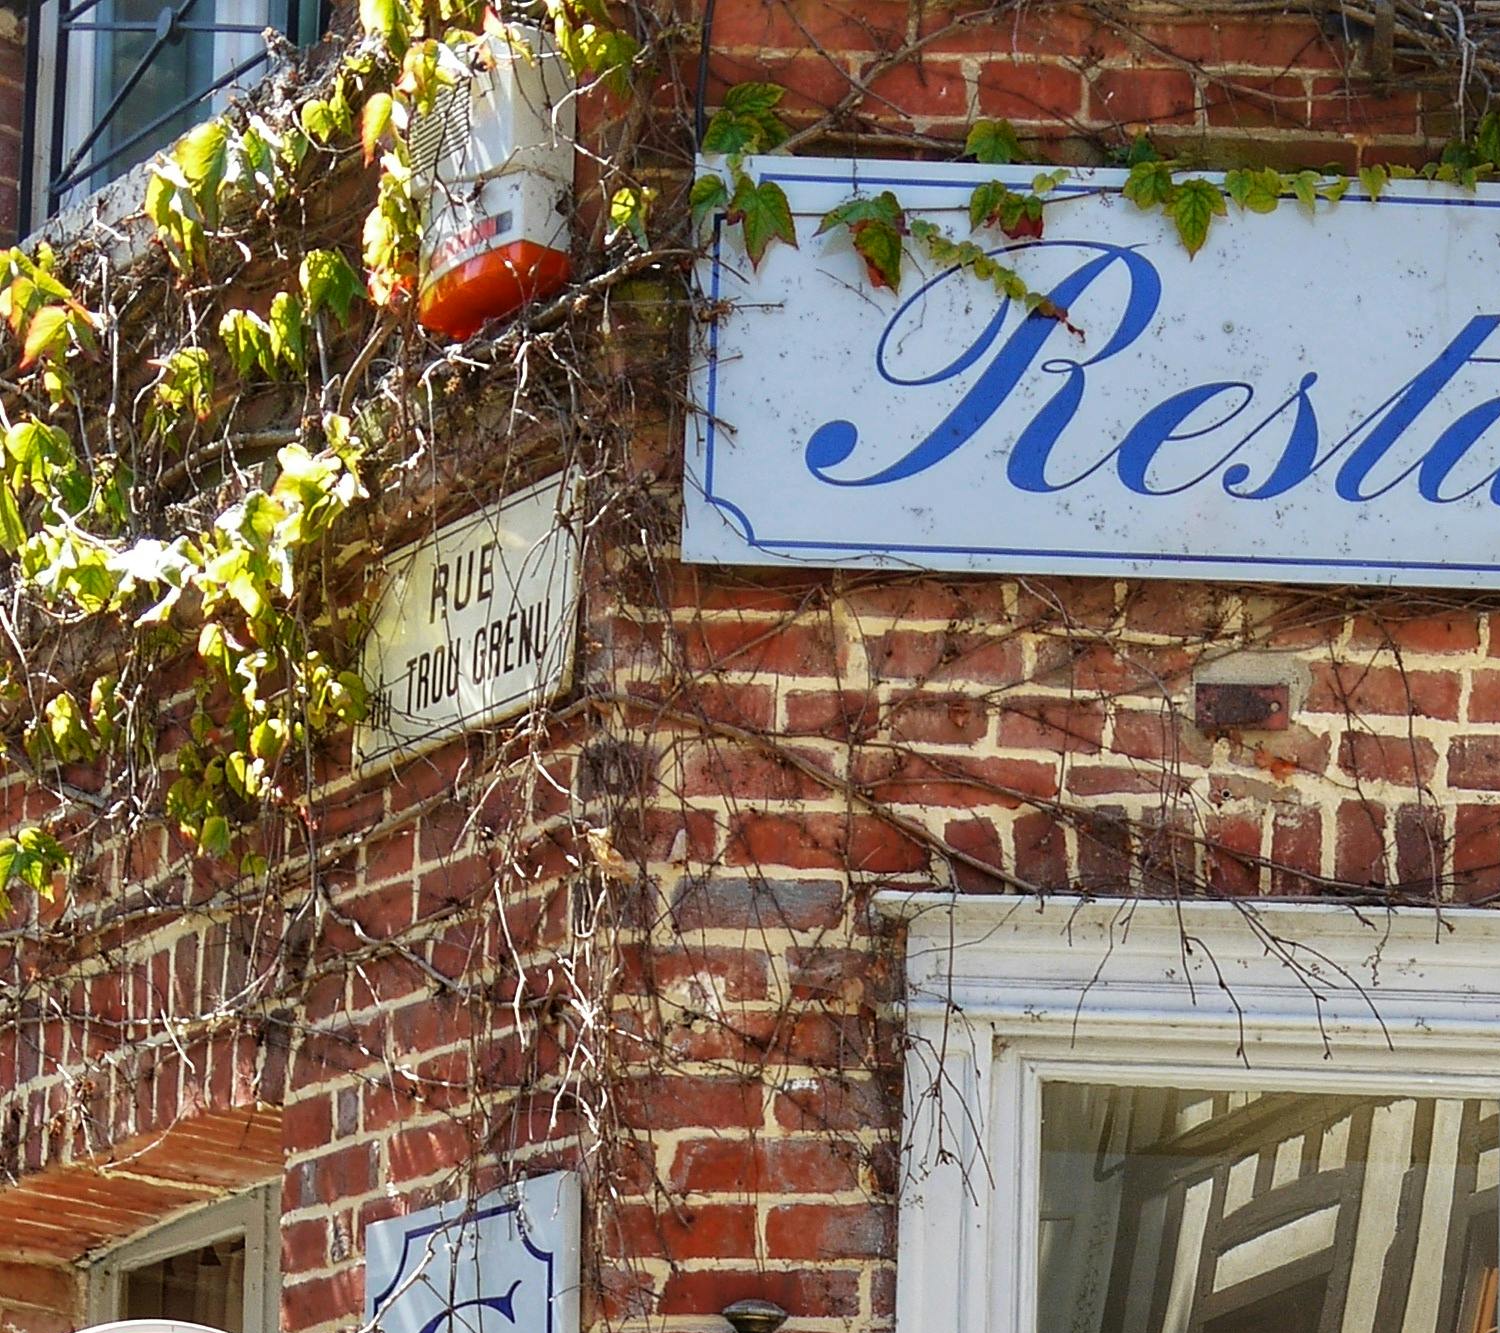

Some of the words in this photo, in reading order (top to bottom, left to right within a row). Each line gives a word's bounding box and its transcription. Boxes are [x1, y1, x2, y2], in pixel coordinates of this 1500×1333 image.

[429, 541, 497, 625] RUE
[406, 637, 461, 717] TROU
[472, 598, 551, 685] GRENU
